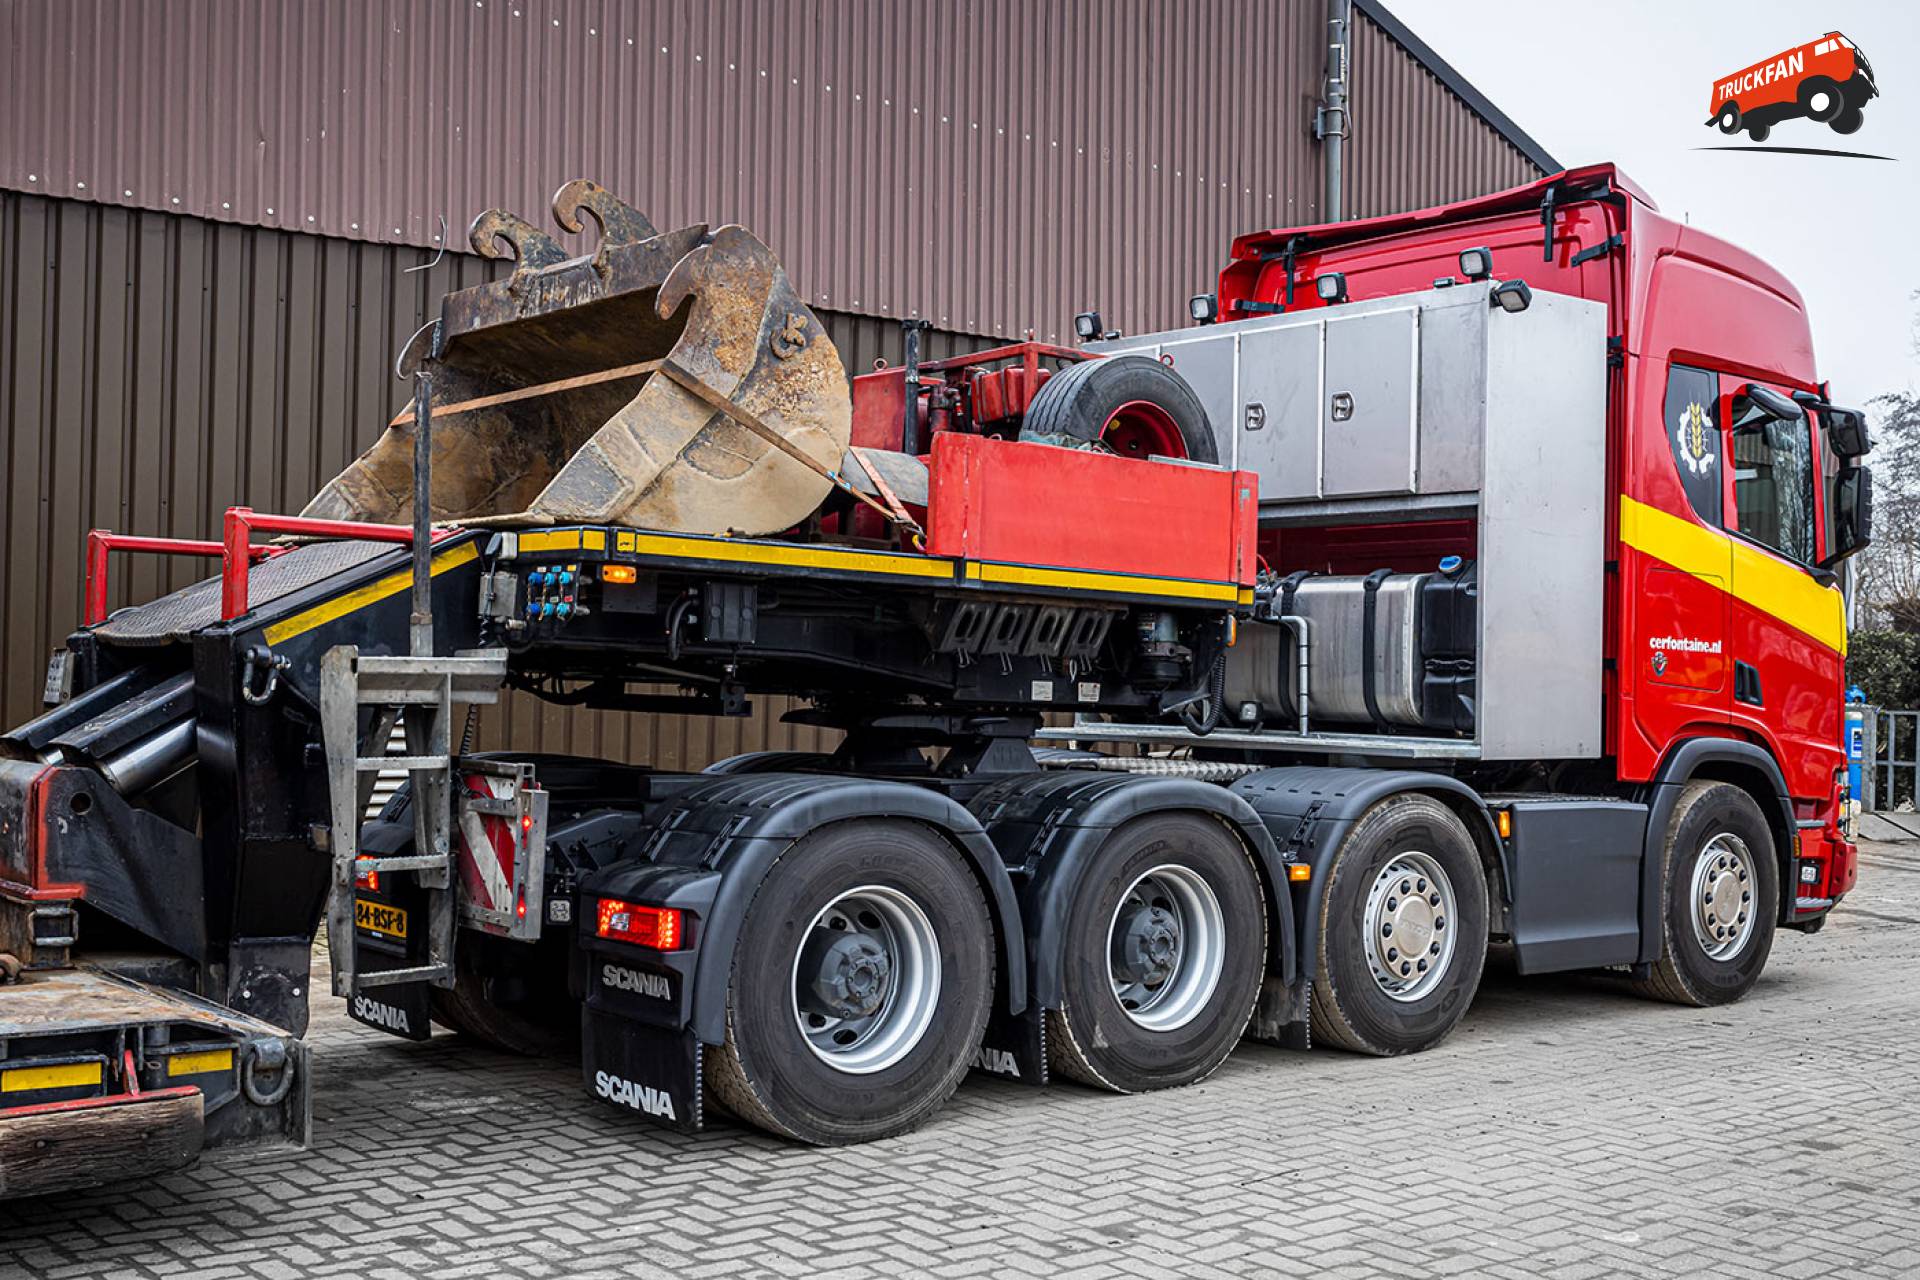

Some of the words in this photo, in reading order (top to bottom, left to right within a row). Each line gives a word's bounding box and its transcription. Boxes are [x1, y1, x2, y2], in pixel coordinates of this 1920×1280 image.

[1649, 635, 1722, 654] cerfontaine.nl
[602, 964, 671, 1000] SCANIA
[354, 995, 410, 1033] SCANIA
[972, 1047, 1021, 1077] NIA
[595, 1070, 676, 1121] SCANIA
